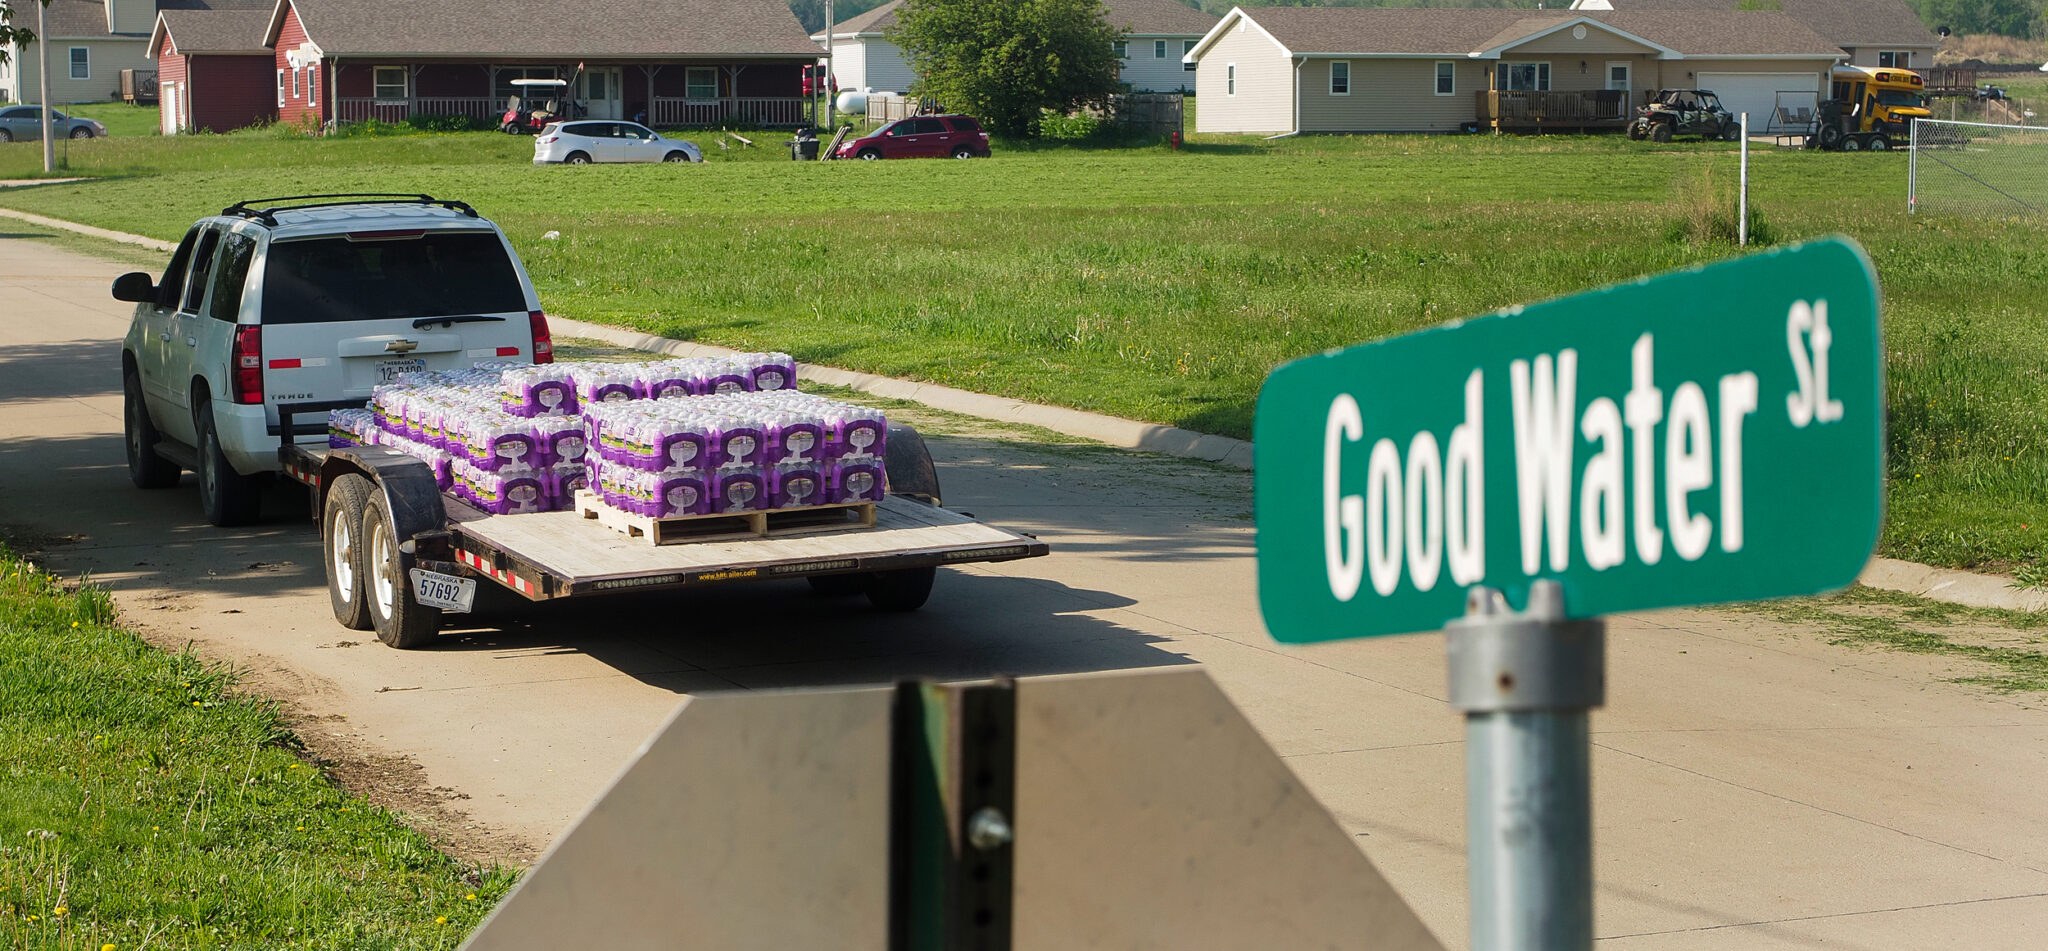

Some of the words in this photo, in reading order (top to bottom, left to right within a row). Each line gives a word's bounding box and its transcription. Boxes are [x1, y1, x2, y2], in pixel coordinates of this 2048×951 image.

[1323, 366, 1486, 602] Good
[1510, 331, 1759, 575] Water
[426, 573, 458, 584] NEBRASKA
[420, 579, 460, 602] 57692
